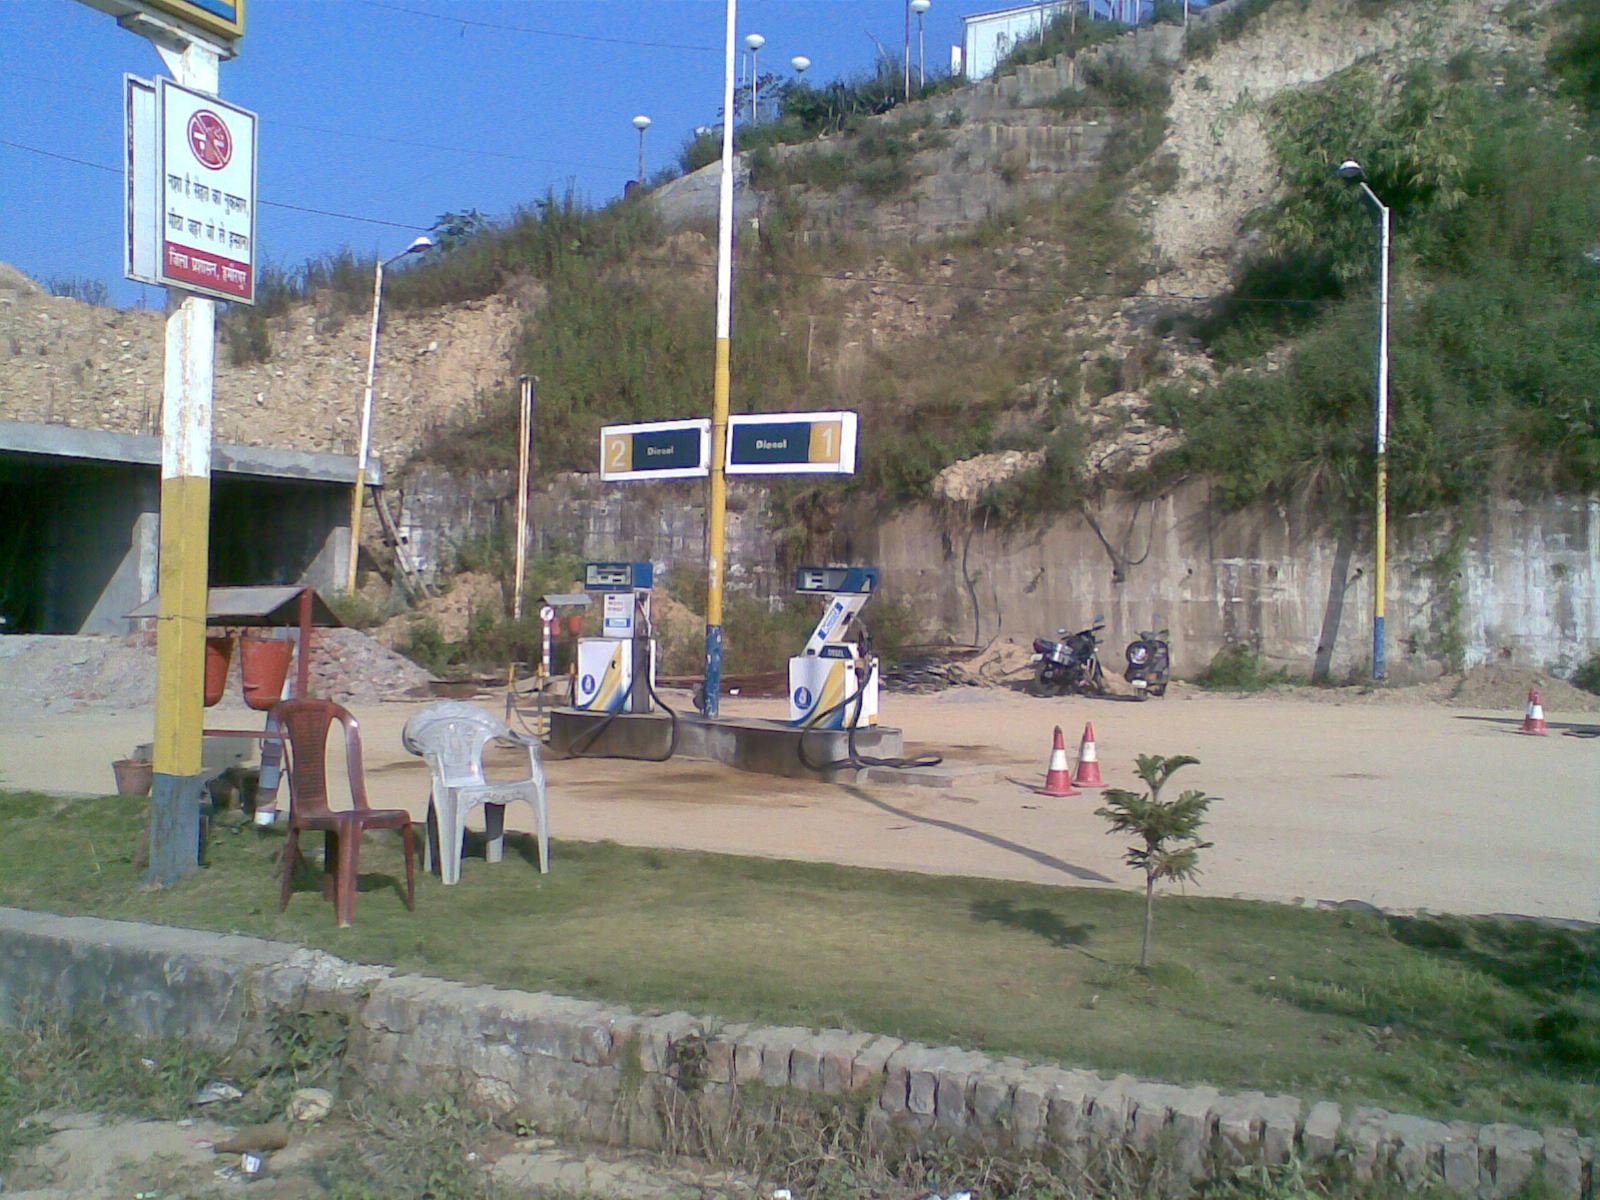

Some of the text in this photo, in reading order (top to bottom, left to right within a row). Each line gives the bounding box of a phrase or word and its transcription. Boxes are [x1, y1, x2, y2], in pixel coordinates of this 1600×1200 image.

[184, 172, 191, 199] है
[168, 246, 189, 269] जिला
[610, 439, 675, 468] 2 Diesel
[755, 427, 834, 458] Diesel 1
